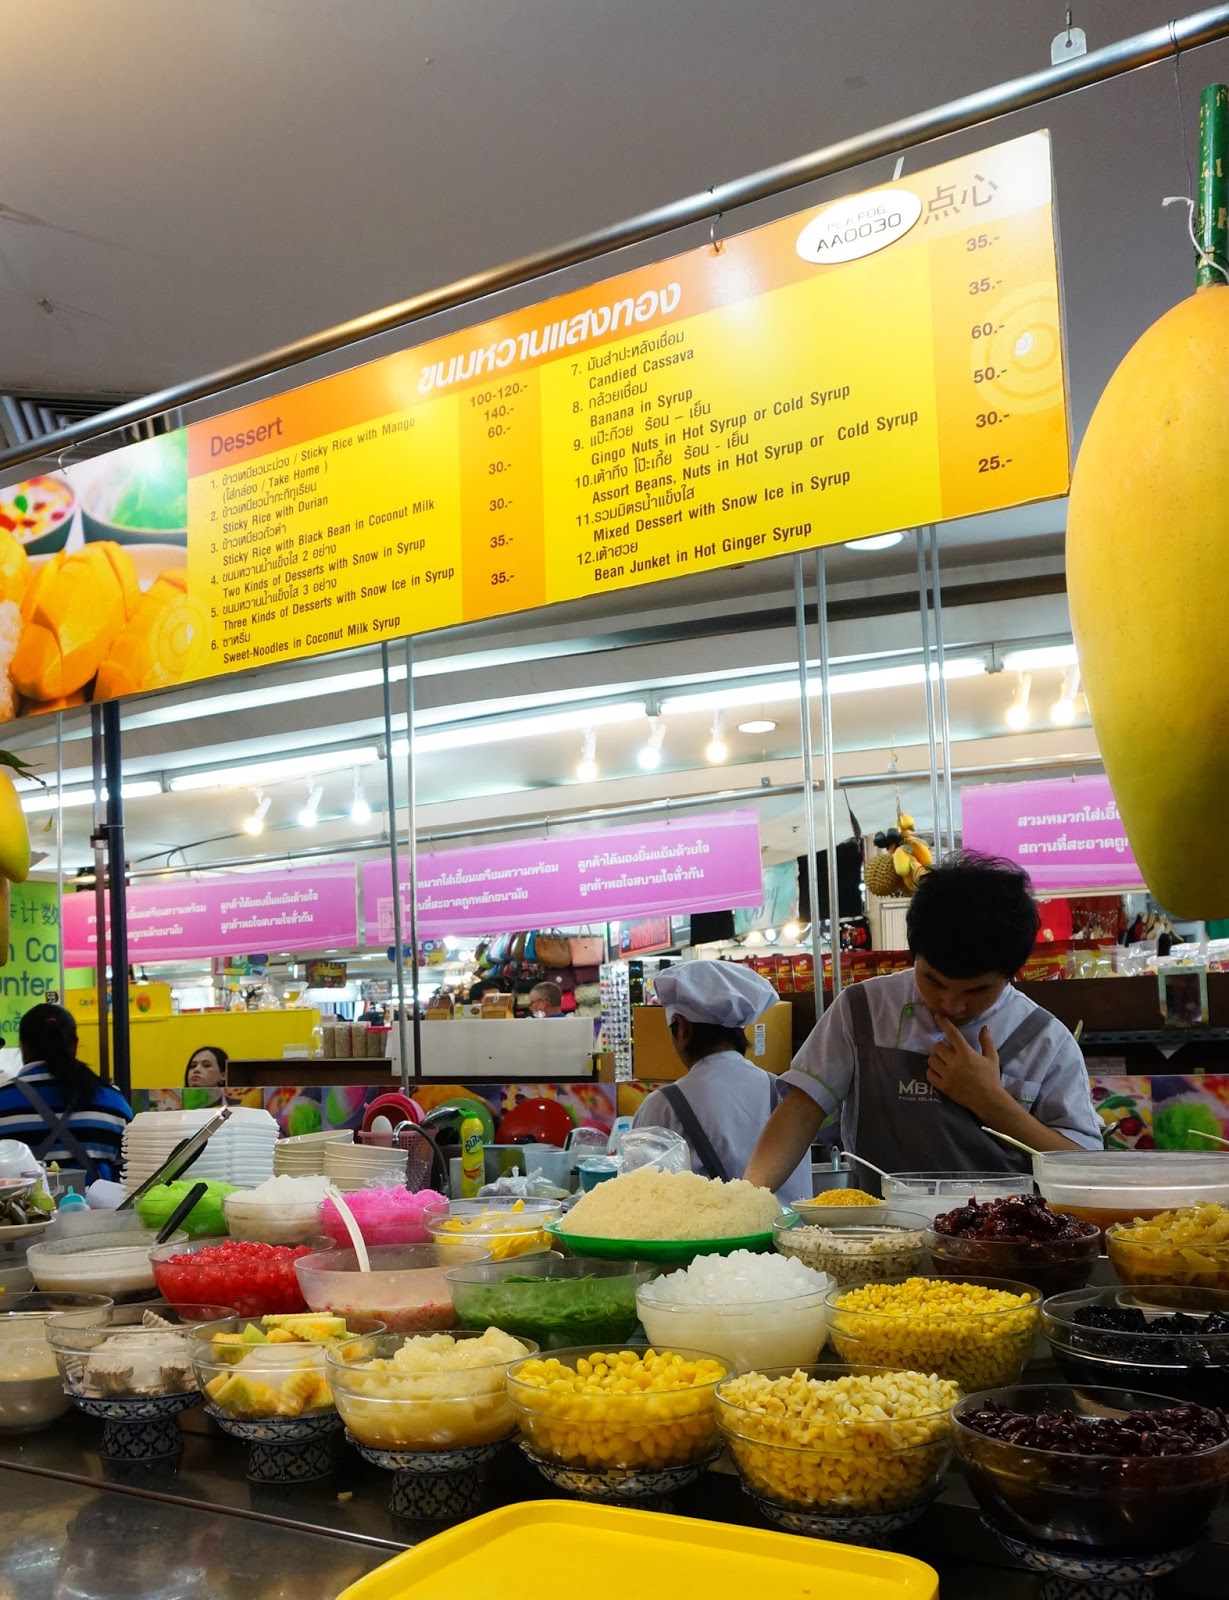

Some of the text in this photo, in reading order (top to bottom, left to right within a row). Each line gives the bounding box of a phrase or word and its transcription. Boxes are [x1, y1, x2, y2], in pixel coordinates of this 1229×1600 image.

[923, 173, 999, 225] 点心
[417, 282, 681, 393] ขนมหวานแสงทอง
[588, 348, 694, 390] Candied Cassava
[589, 388, 693, 428] Banana in Syrup
[590, 385, 851, 466] Gingo Nuts in Hot Syrup or Cold Syrup
[210, 416, 283, 457] Dessert
[300, 445, 328, 462] Sticky
[332, 437, 353, 452] Rice
[357, 428, 377, 444] with
[382, 418, 415, 436] Mango
[592, 410, 919, 505] Assort Beans, Nuts in Hot Syrup or Cold Syrup
[268, 474, 290, 488] Take
[293, 464, 320, 481] Home
[222, 495, 329, 535] Sticky Rice with Durian
[593, 470, 851, 543] Mixed Dessert with Snow Ice in Syrup
[222, 498, 435, 567] Sticky Rice with Black Bean in Coconut Milk
[302, 549, 309, 562] 2
[594, 522, 812, 582] Bean Junket in Hot Ginger Syrup
[222, 538, 426, 599] Two Kinds of Desserts with Snow in Syrup
[302, 583, 309, 596] 3
[222, 567, 455, 632] Three Kinds of Desserts with Snow Ice in Syrup
[223, 616, 401, 665] Sweet-Noodles in Coconut Milk Syrup
[0, 971, 54, 997] nter
